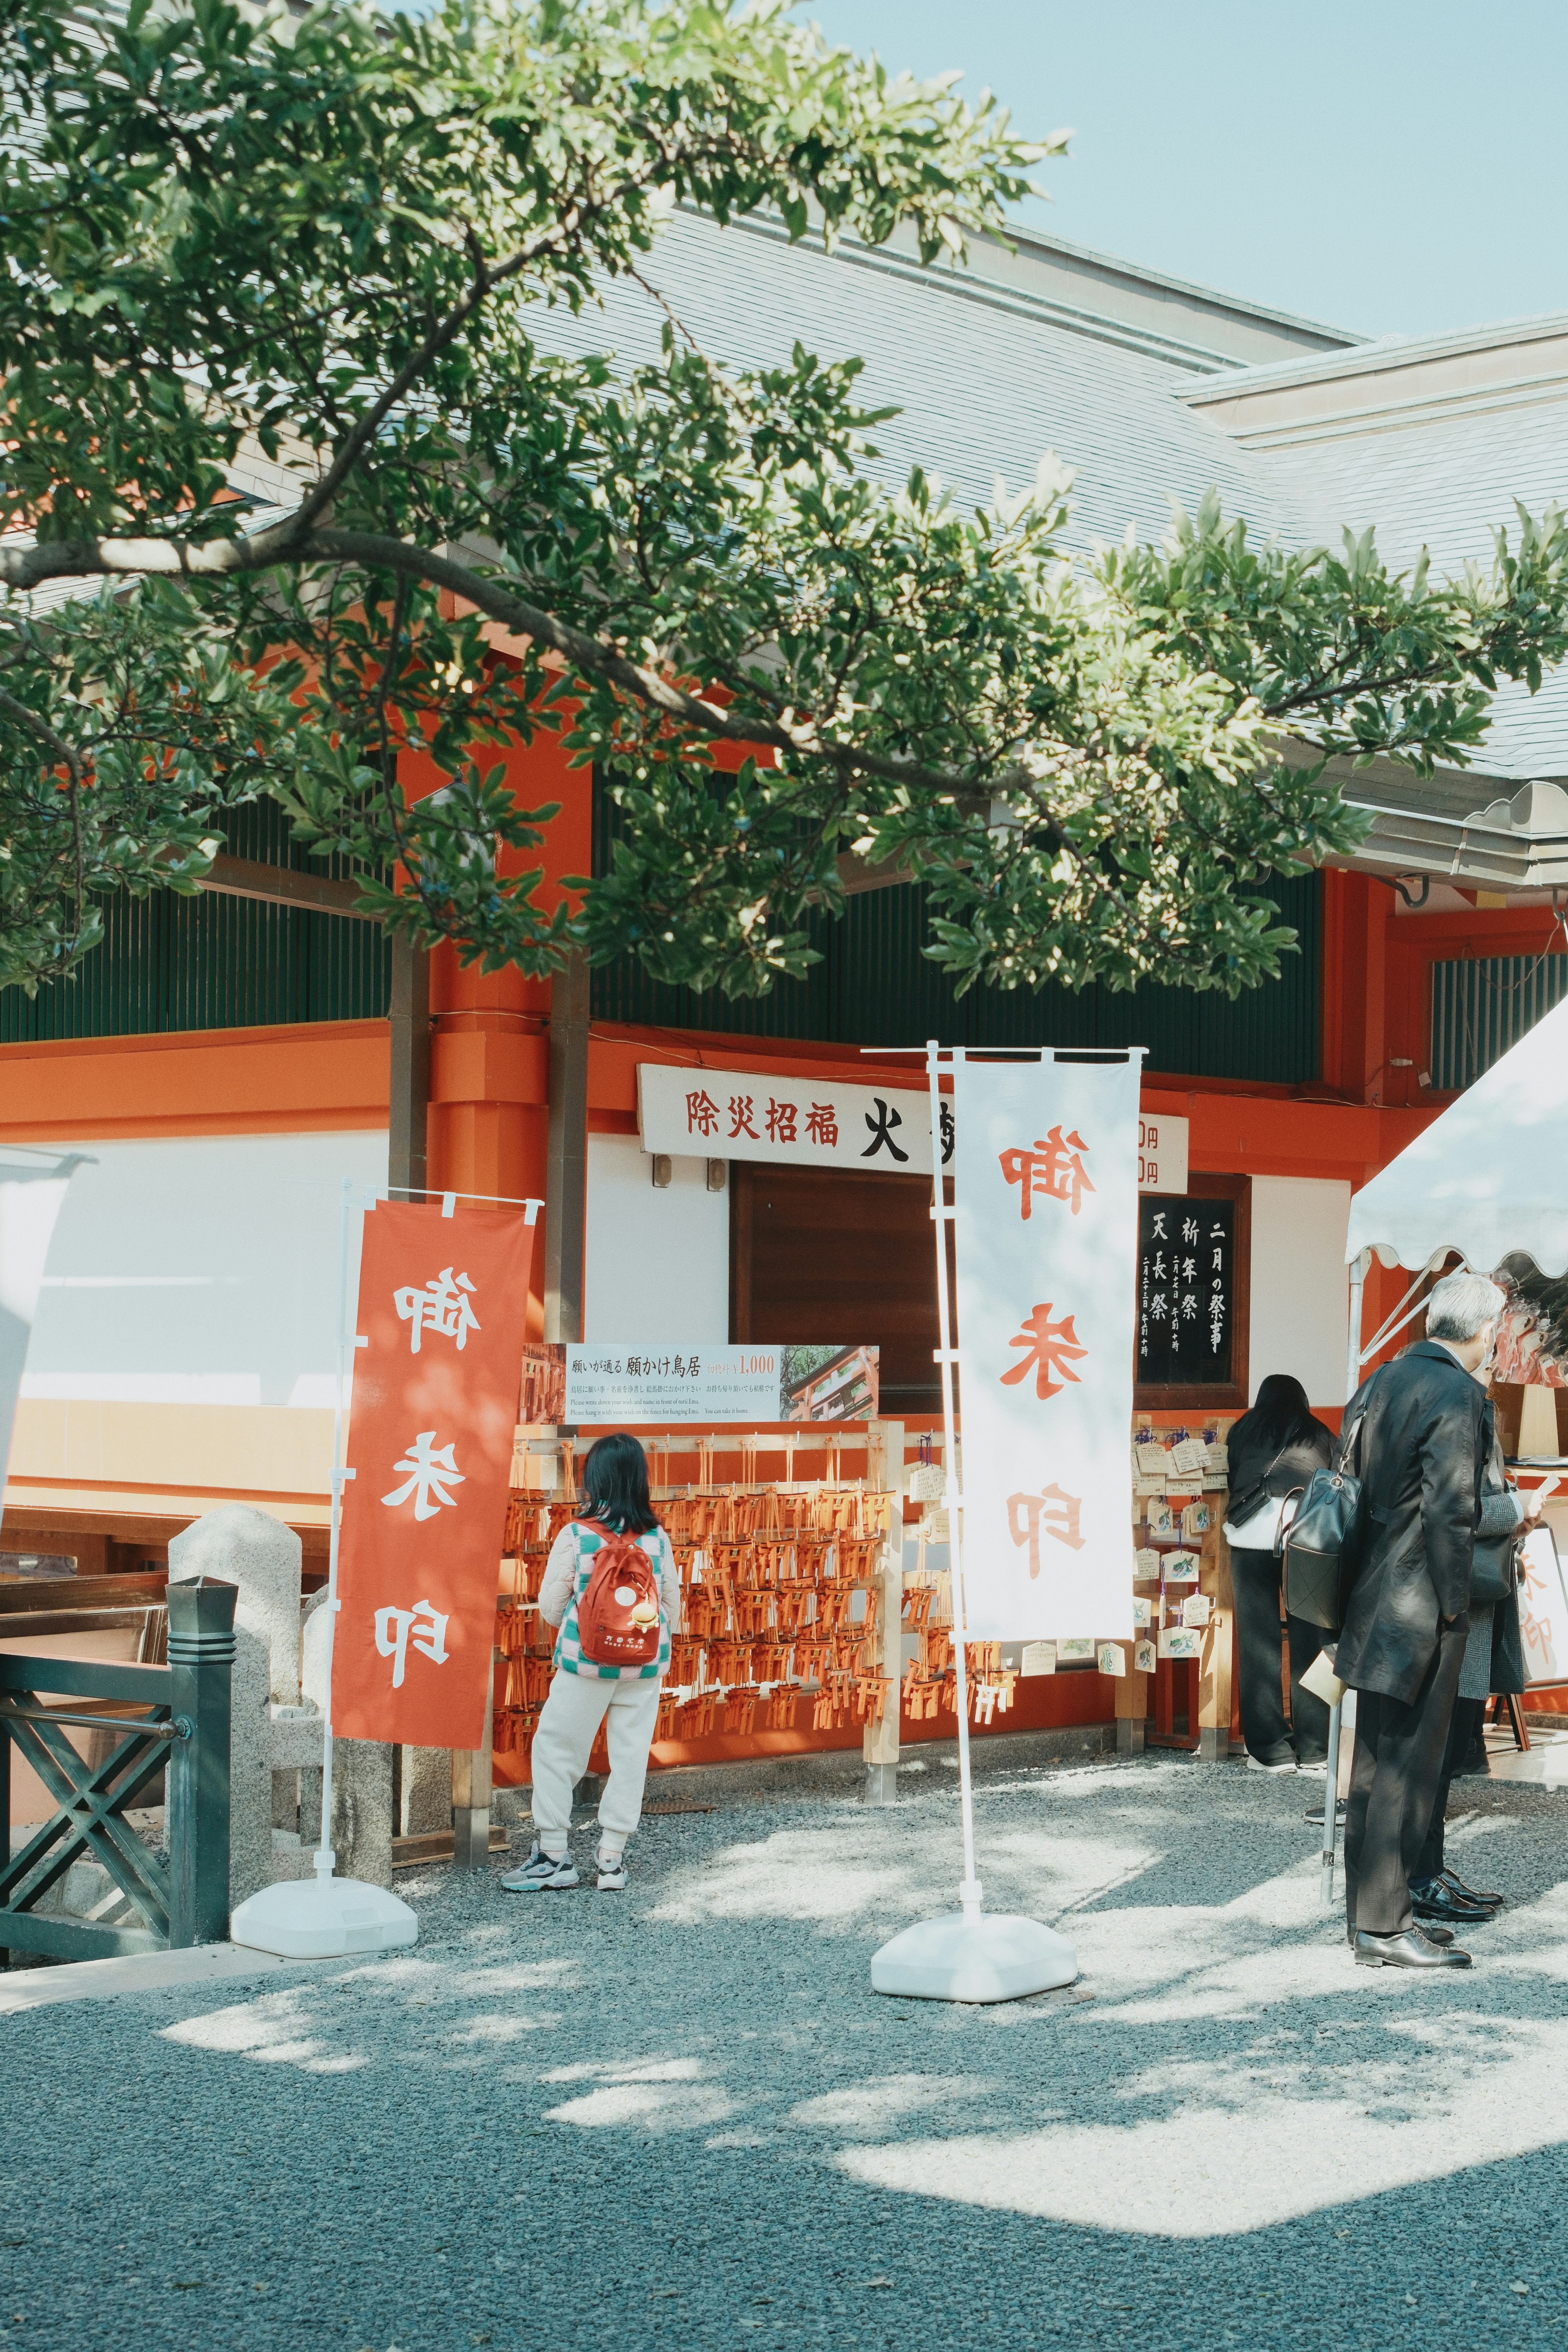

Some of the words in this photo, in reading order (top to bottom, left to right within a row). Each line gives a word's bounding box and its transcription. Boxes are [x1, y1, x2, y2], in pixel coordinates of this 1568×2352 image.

[686, 1090, 839, 1147] 除災招福
[1149, 1212, 1168, 1321] 天長祭
[1181, 1217, 1199, 1320] 祈年祭
[1208, 1223, 1225, 1353] 二月の祭事
[1171, 1307, 1179, 1352] 午前十時
[571, 1360, 622, 1374] 願いが通る
[626, 1354, 701, 1378] 願かけ鳥居
[707, 1363, 729, 1374] 初穂料
[732, 1355, 774, 1376] ¥1,000
[706, 1384, 774, 1393] お持ち帰り頂いても結構です
